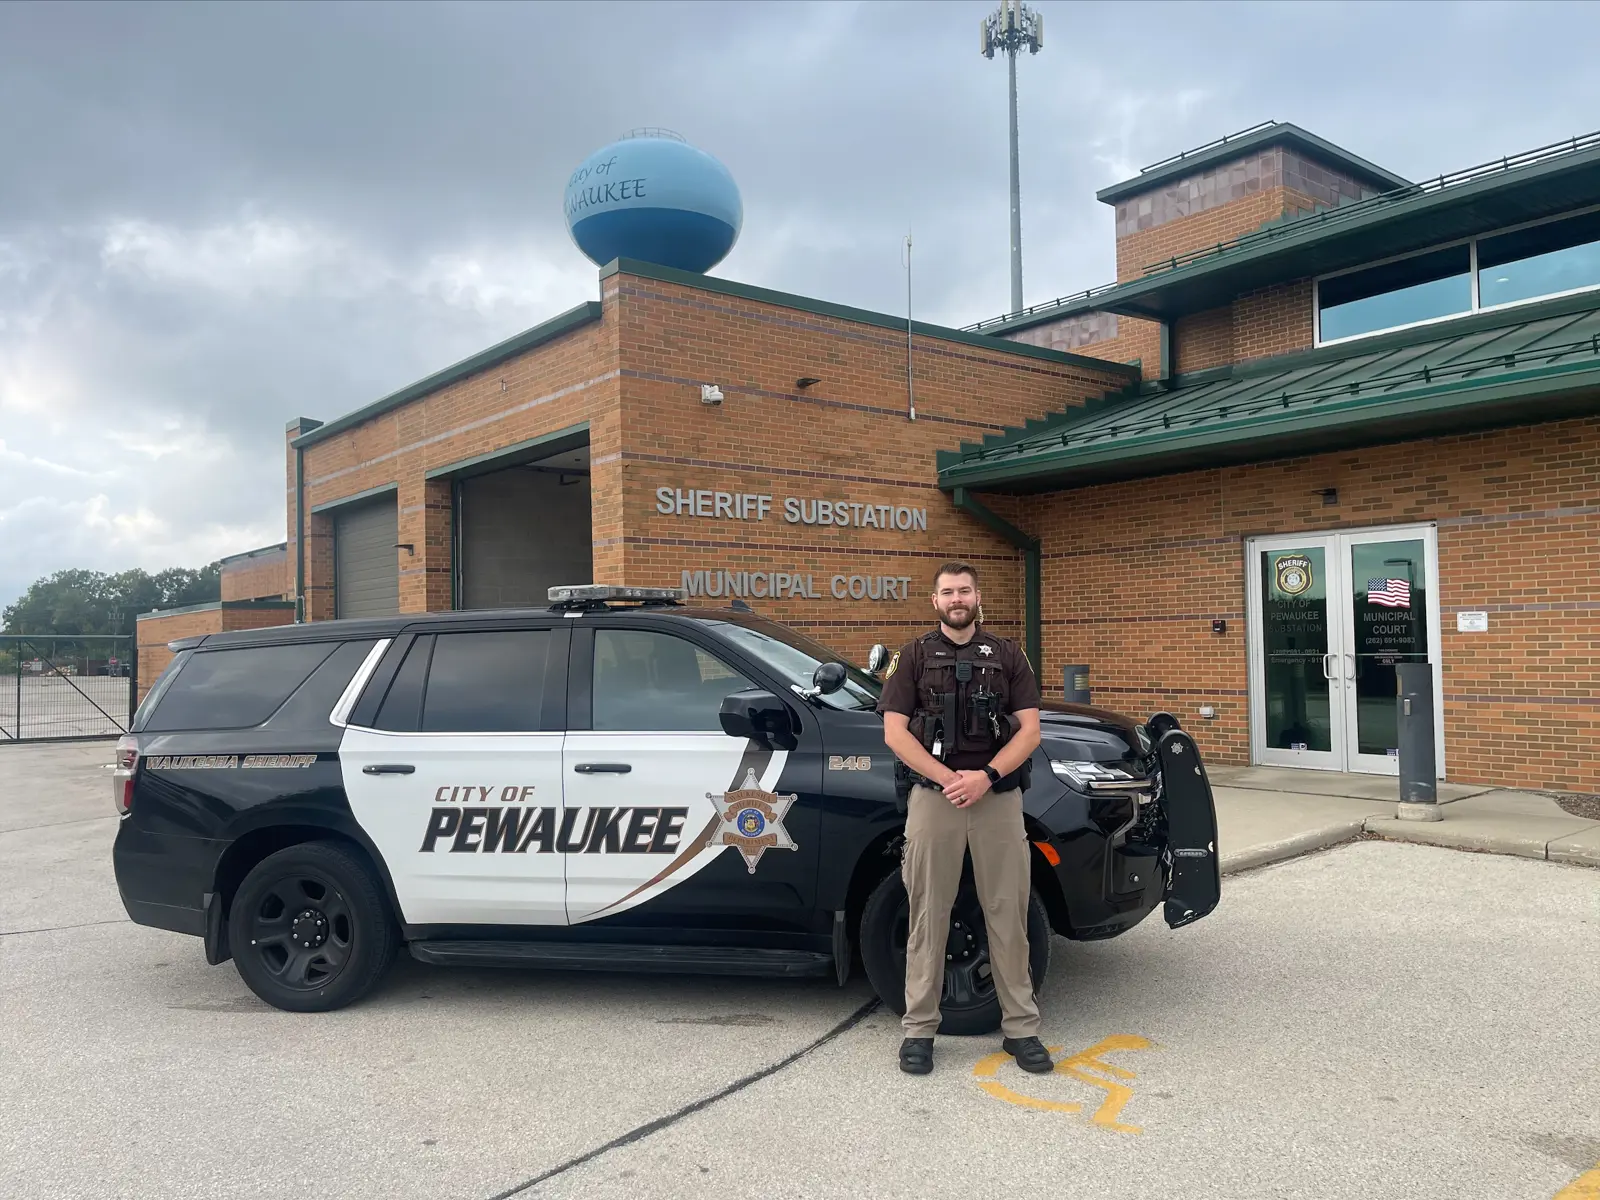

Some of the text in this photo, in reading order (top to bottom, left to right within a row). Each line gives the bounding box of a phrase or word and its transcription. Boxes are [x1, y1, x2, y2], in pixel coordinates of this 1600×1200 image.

[596, 156, 618, 175] of
[566, 178, 648, 217] WAUKEE
[655, 487, 927, 531] SHERIFF SUBSTATION
[1278, 559, 1308, 570] SHERIFF
[681, 569, 911, 601] MUNICIPAL COURT
[1277, 599, 1311, 609] CITY OF
[1270, 611, 1320, 621] PEWAUKEE
[1363, 611, 1416, 621] MUNICIPAL
[1372, 624, 1407, 634] COURT
[145, 754, 318, 770] WAUKESHA SHERIFF
[828, 755, 872, 771] 246
[434, 785, 536, 802] CITY OF
[417, 805, 690, 855] PEWAUKEE
